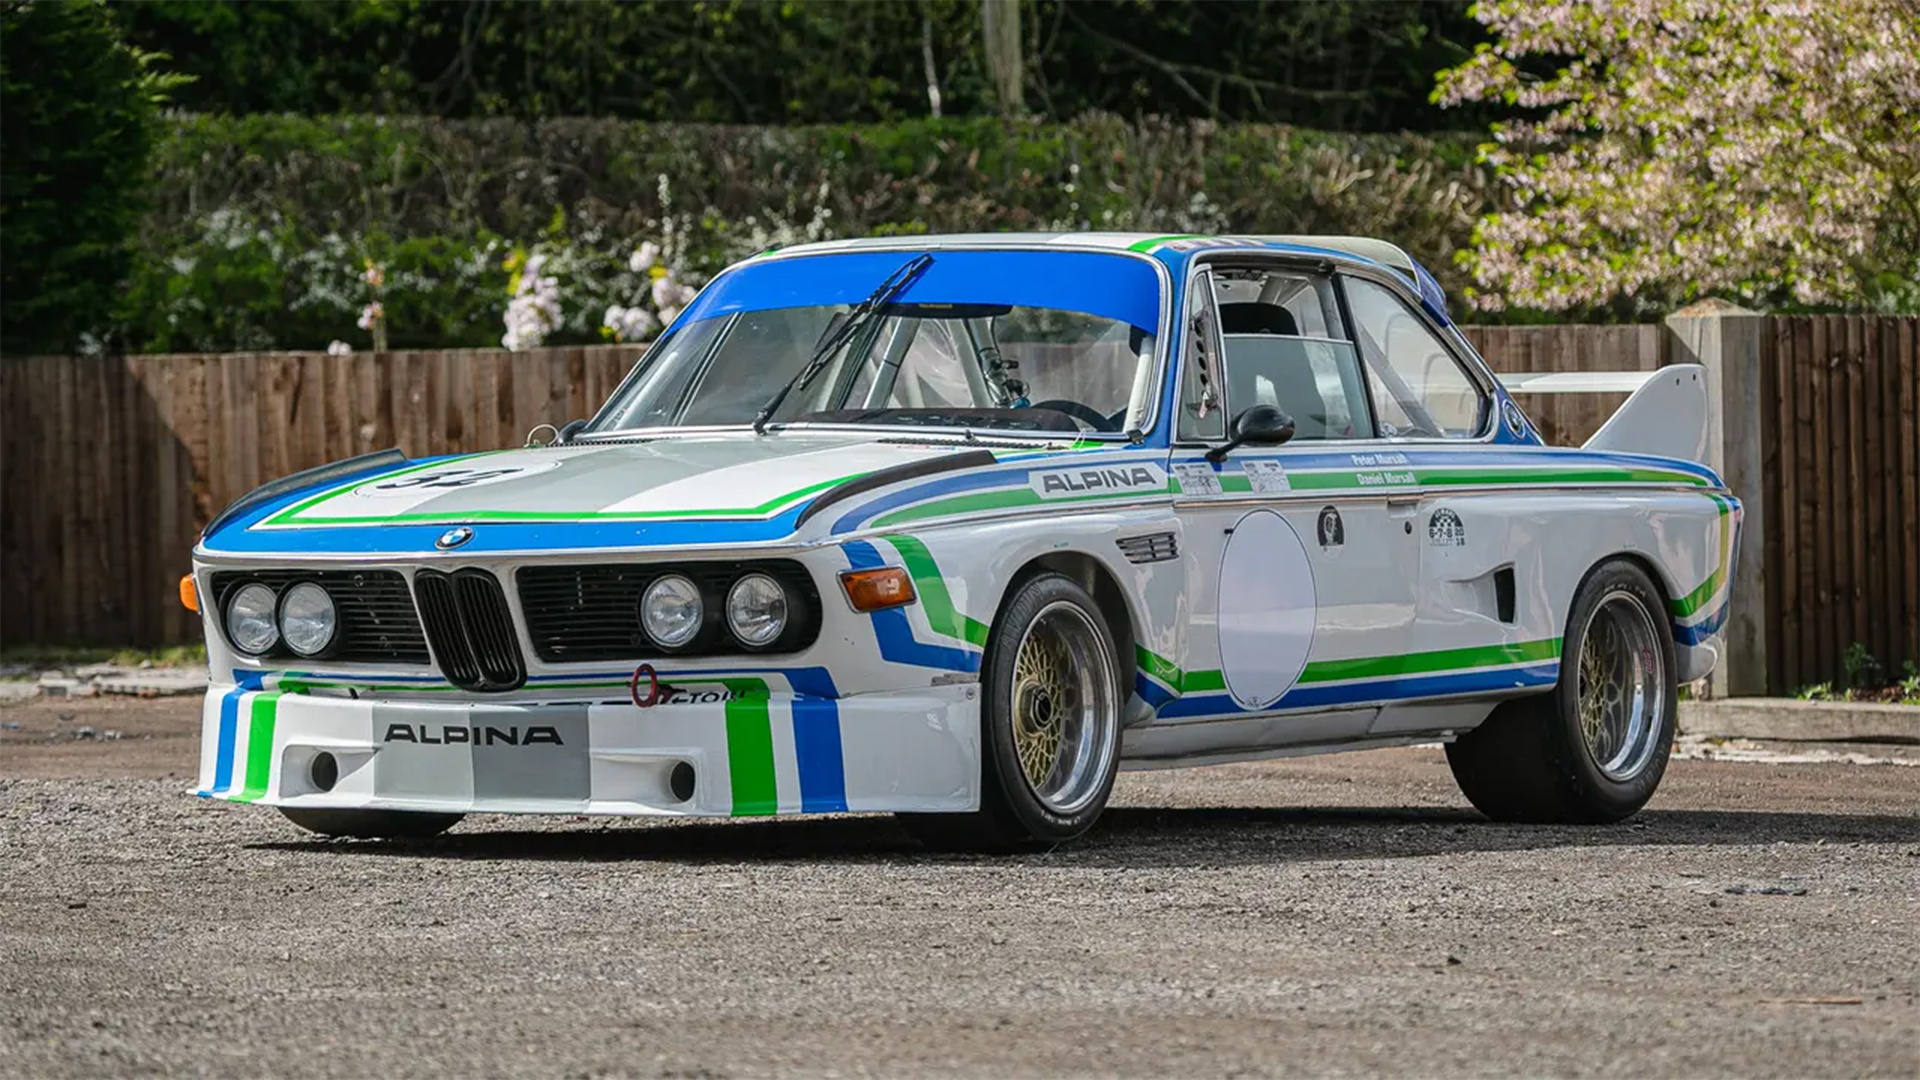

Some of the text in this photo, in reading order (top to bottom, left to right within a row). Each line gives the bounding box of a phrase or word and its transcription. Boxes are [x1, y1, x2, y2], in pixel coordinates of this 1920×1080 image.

[1042, 467, 1157, 493] ALPINA
[1356, 471, 1385, 486] Daniel
[384, 723, 565, 746] ALPINA
